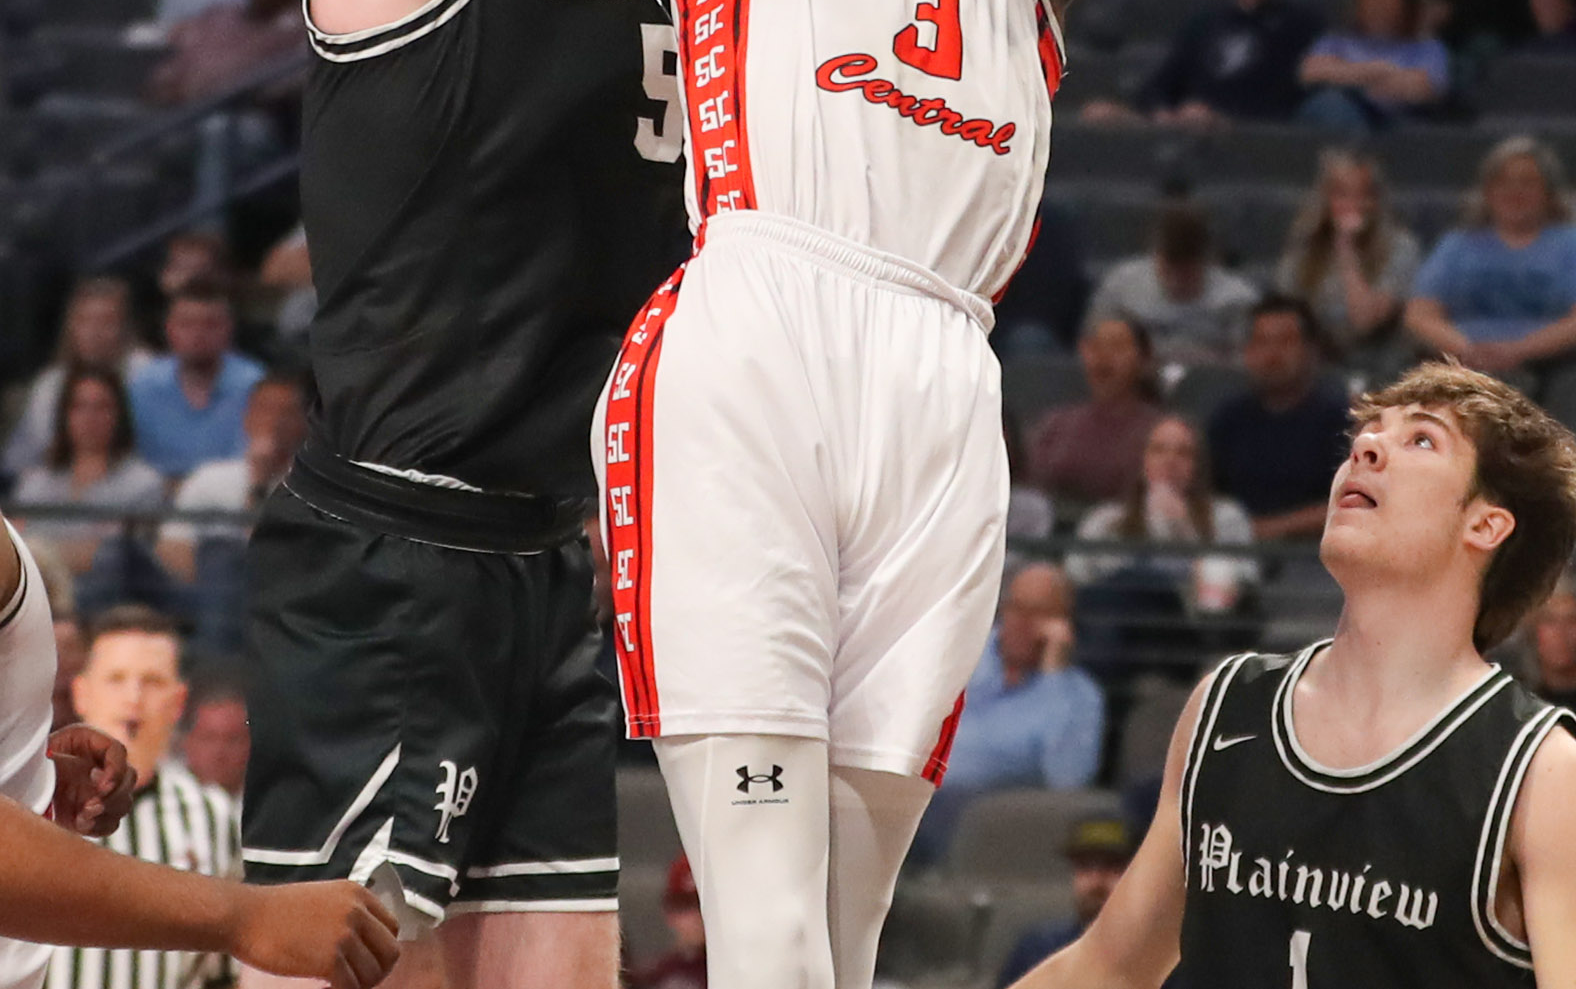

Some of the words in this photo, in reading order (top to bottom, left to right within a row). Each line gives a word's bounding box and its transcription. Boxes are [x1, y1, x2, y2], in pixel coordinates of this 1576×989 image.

[694, 4, 725, 46] SC
[694, 44, 726, 88] SC
[633, 22, 684, 164] 5
[698, 90, 733, 133] SC
[815, 53, 1016, 155] Central
[704, 140, 739, 180] SC
[608, 422, 631, 464] SC
[1198, 822, 1440, 931] Plainview
